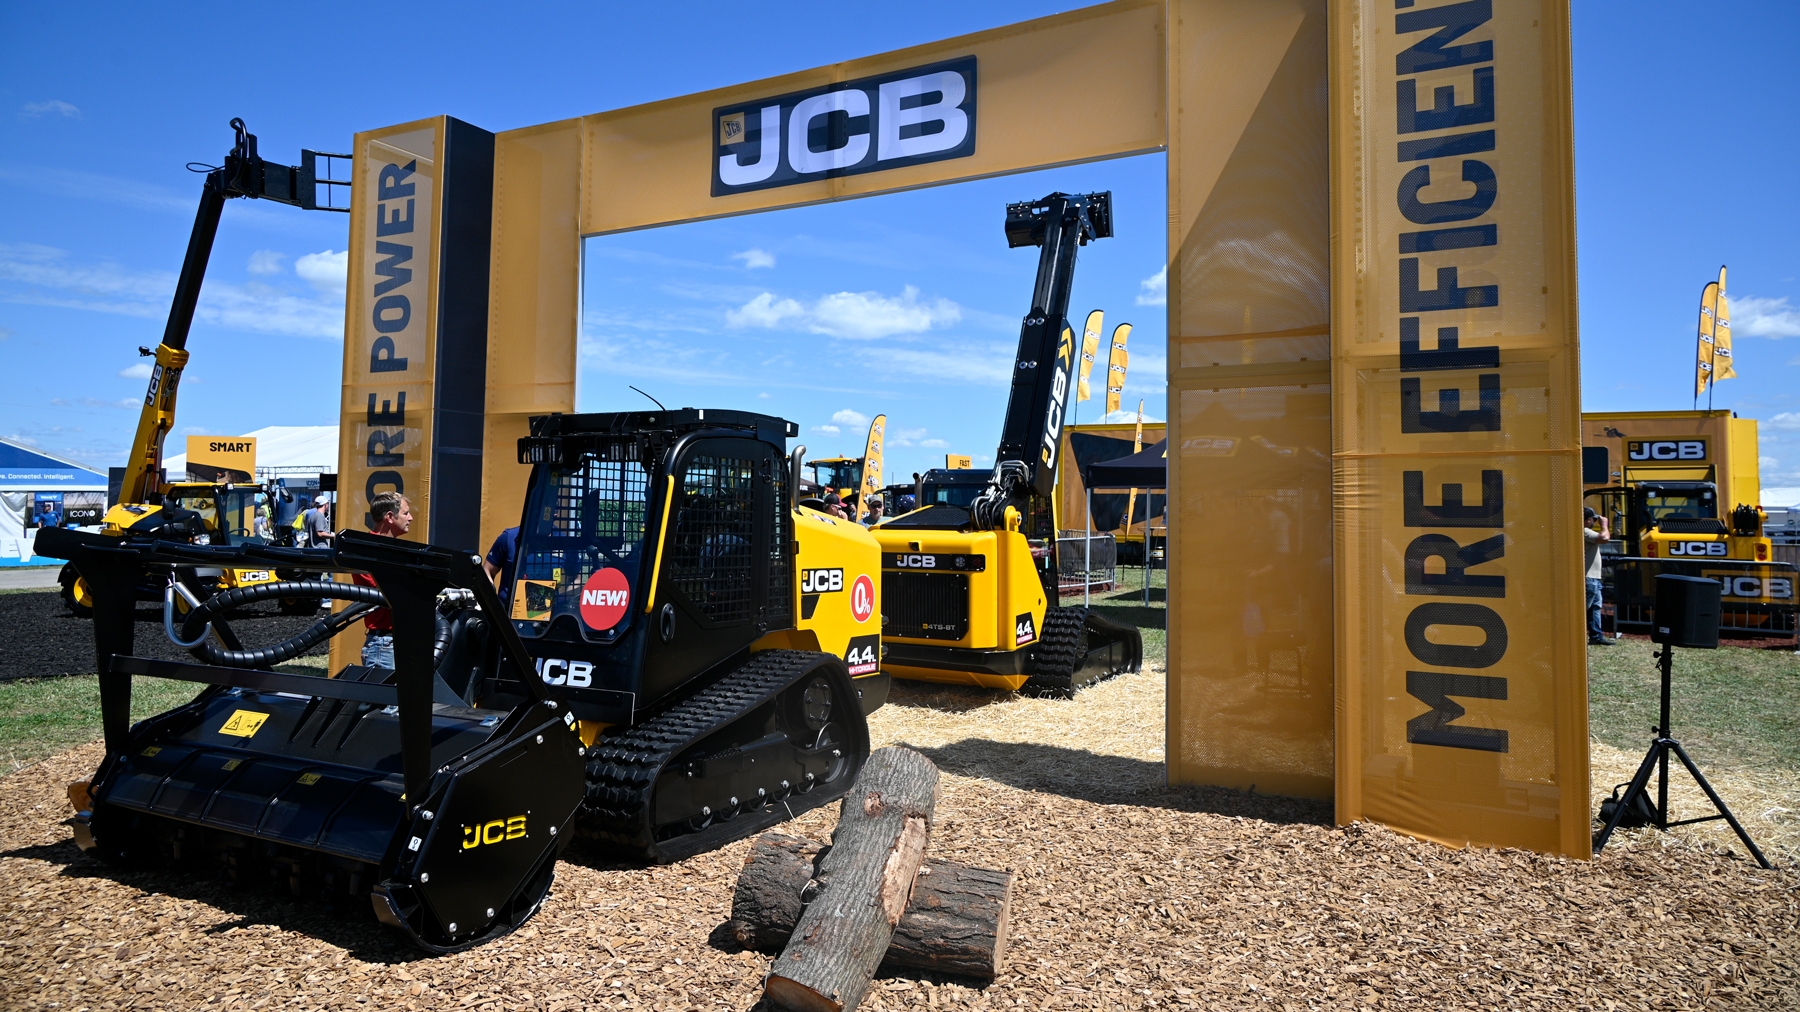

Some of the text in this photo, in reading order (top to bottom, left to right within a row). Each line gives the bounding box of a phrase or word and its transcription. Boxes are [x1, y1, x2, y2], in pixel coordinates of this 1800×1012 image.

[719, 70, 968, 186] JCB
[726, 122, 741, 136] JCB
[365, 159, 416, 531] ORE POWER
[148, 364, 163, 406] JCB
[1395, 0, 1508, 753] MORE EFFICIEN
[1045, 366, 1066, 469] JCB
[209, 442, 252, 452] SMART
[1630, 442, 1704, 460] JCB
[1670, 542, 1726, 556] JCB
[897, 555, 936, 568] JCB
[241, 571, 269, 581] JCB
[802, 569, 843, 592] JCB
[582, 589, 628, 607] NEW!
[854, 582, 870, 615] 0%
[1721, 577, 1791, 598] JCB
[463, 815, 527, 850] JCB
